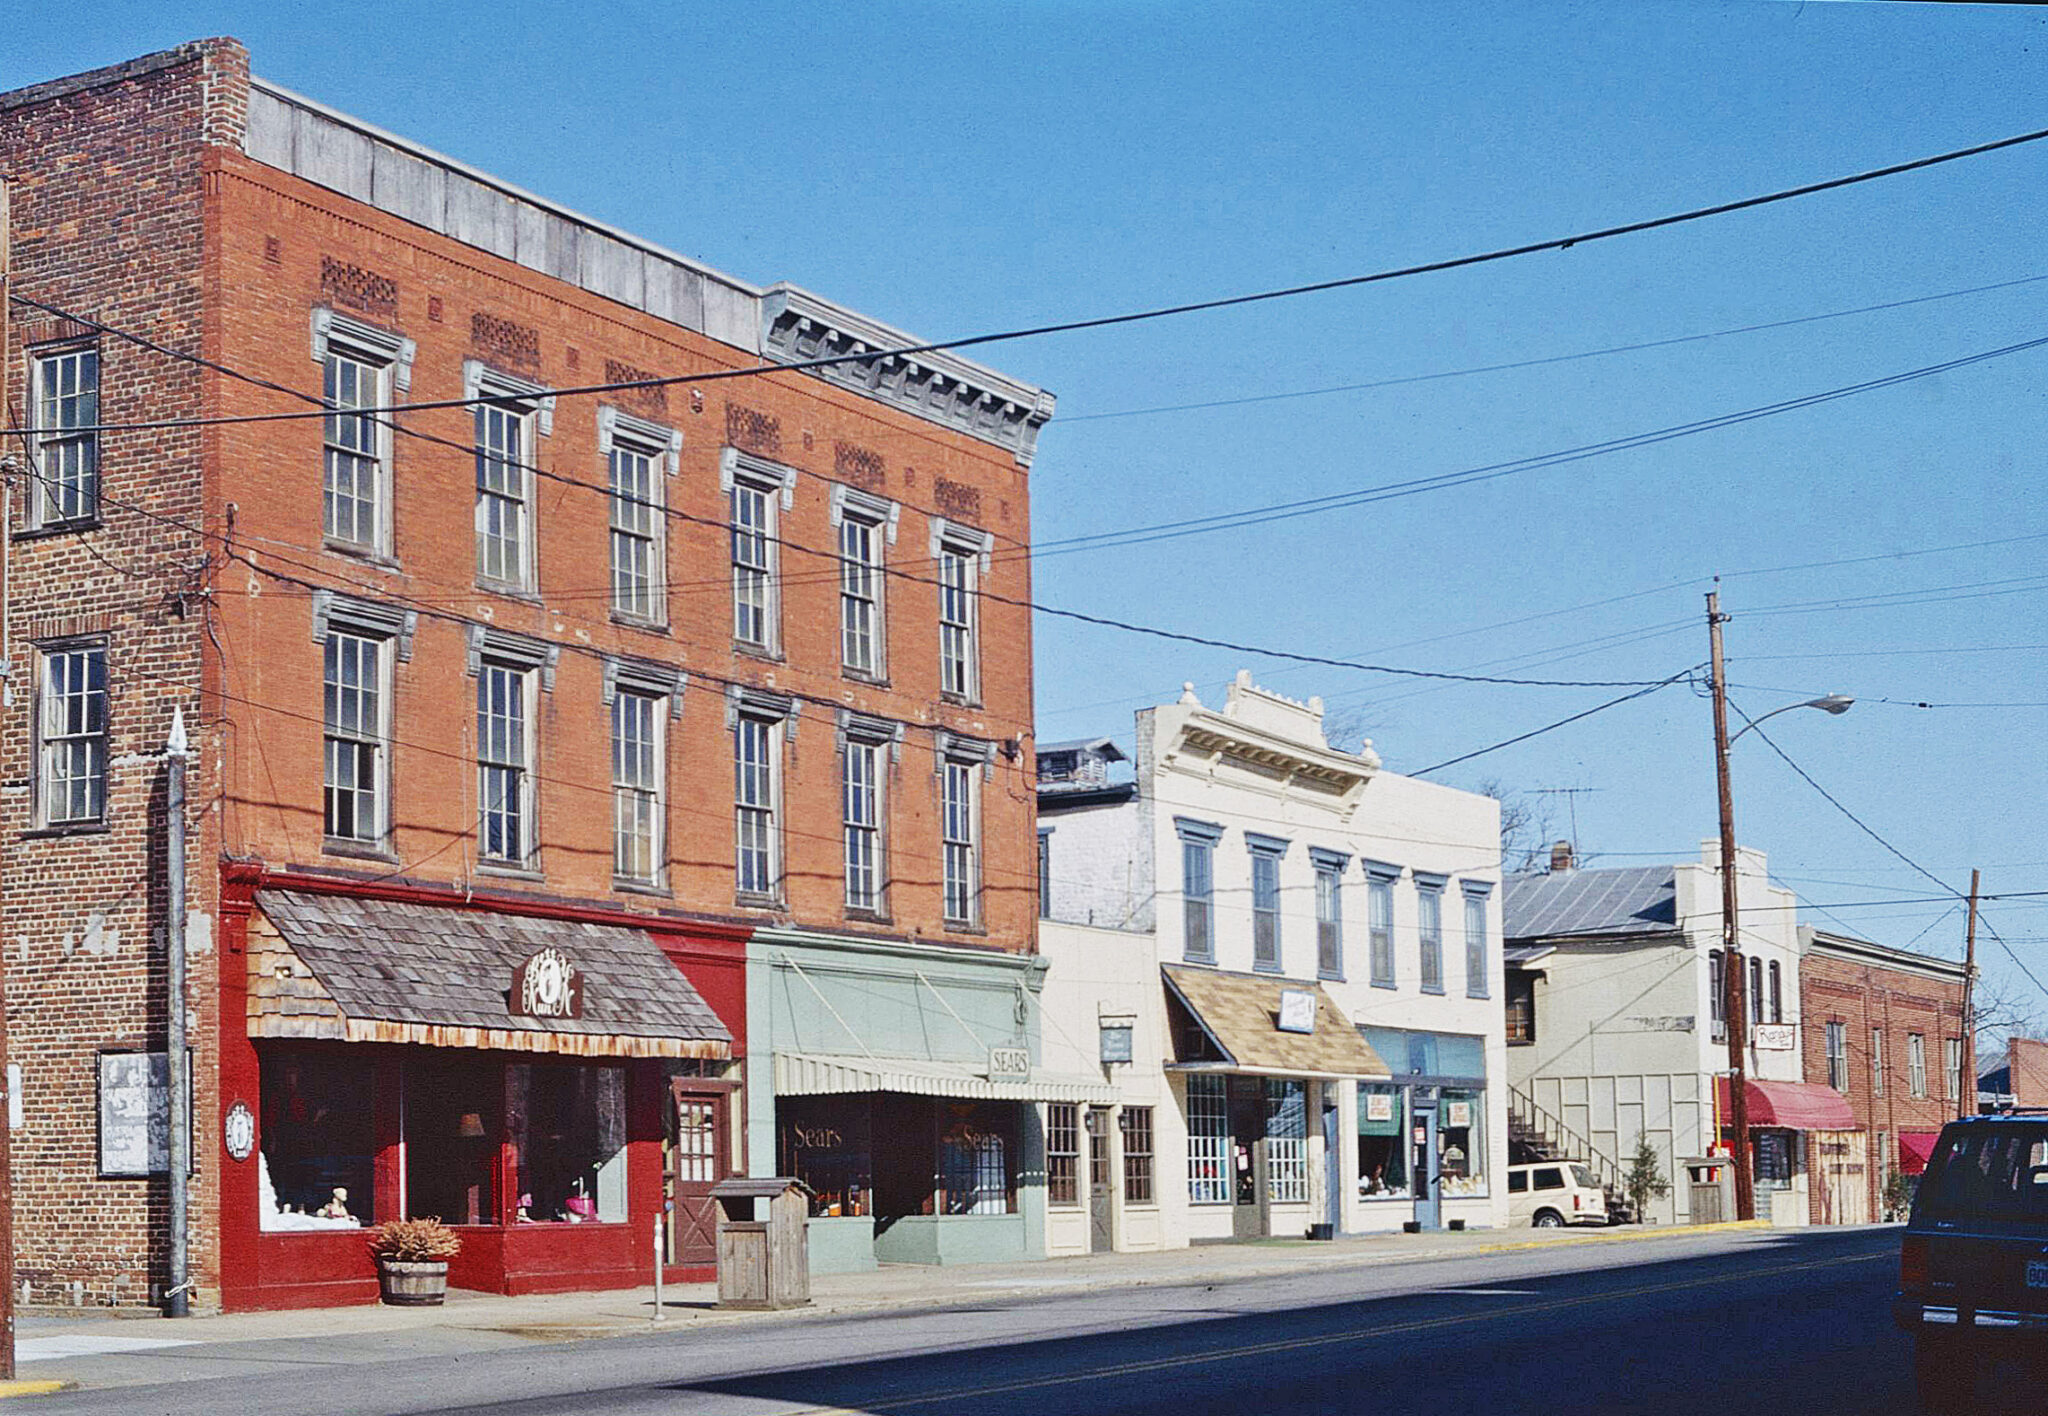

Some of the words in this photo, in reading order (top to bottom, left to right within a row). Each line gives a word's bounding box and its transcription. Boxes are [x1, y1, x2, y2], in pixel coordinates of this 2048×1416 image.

[994, 1052, 1027, 1072] SEARS
[794, 1121, 842, 1148] Sears
[964, 1125, 1004, 1151] Sears
